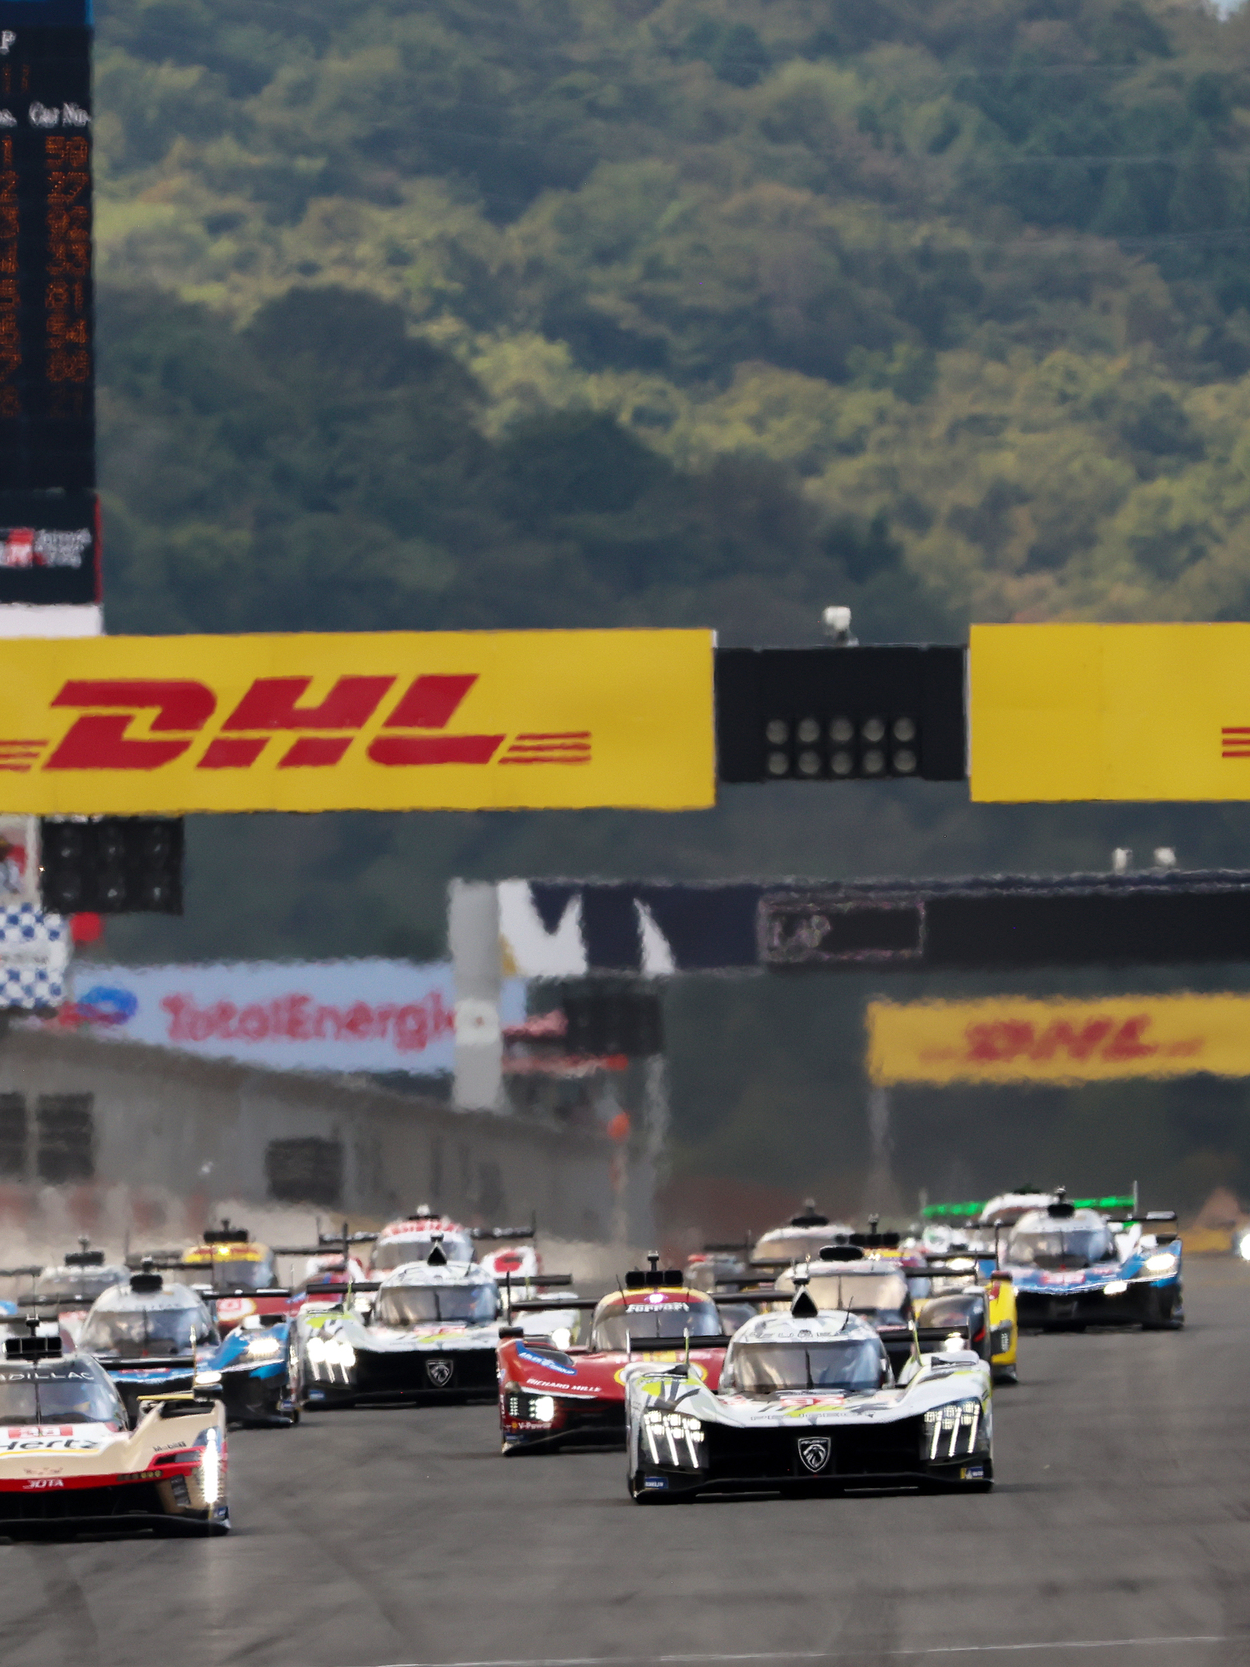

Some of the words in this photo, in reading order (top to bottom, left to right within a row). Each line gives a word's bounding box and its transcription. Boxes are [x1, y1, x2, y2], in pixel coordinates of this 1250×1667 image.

[41, 673, 508, 772] DHL
[161, 989, 456, 1054] TotalEnergi
[964, 1013, 1158, 1063] DHL
